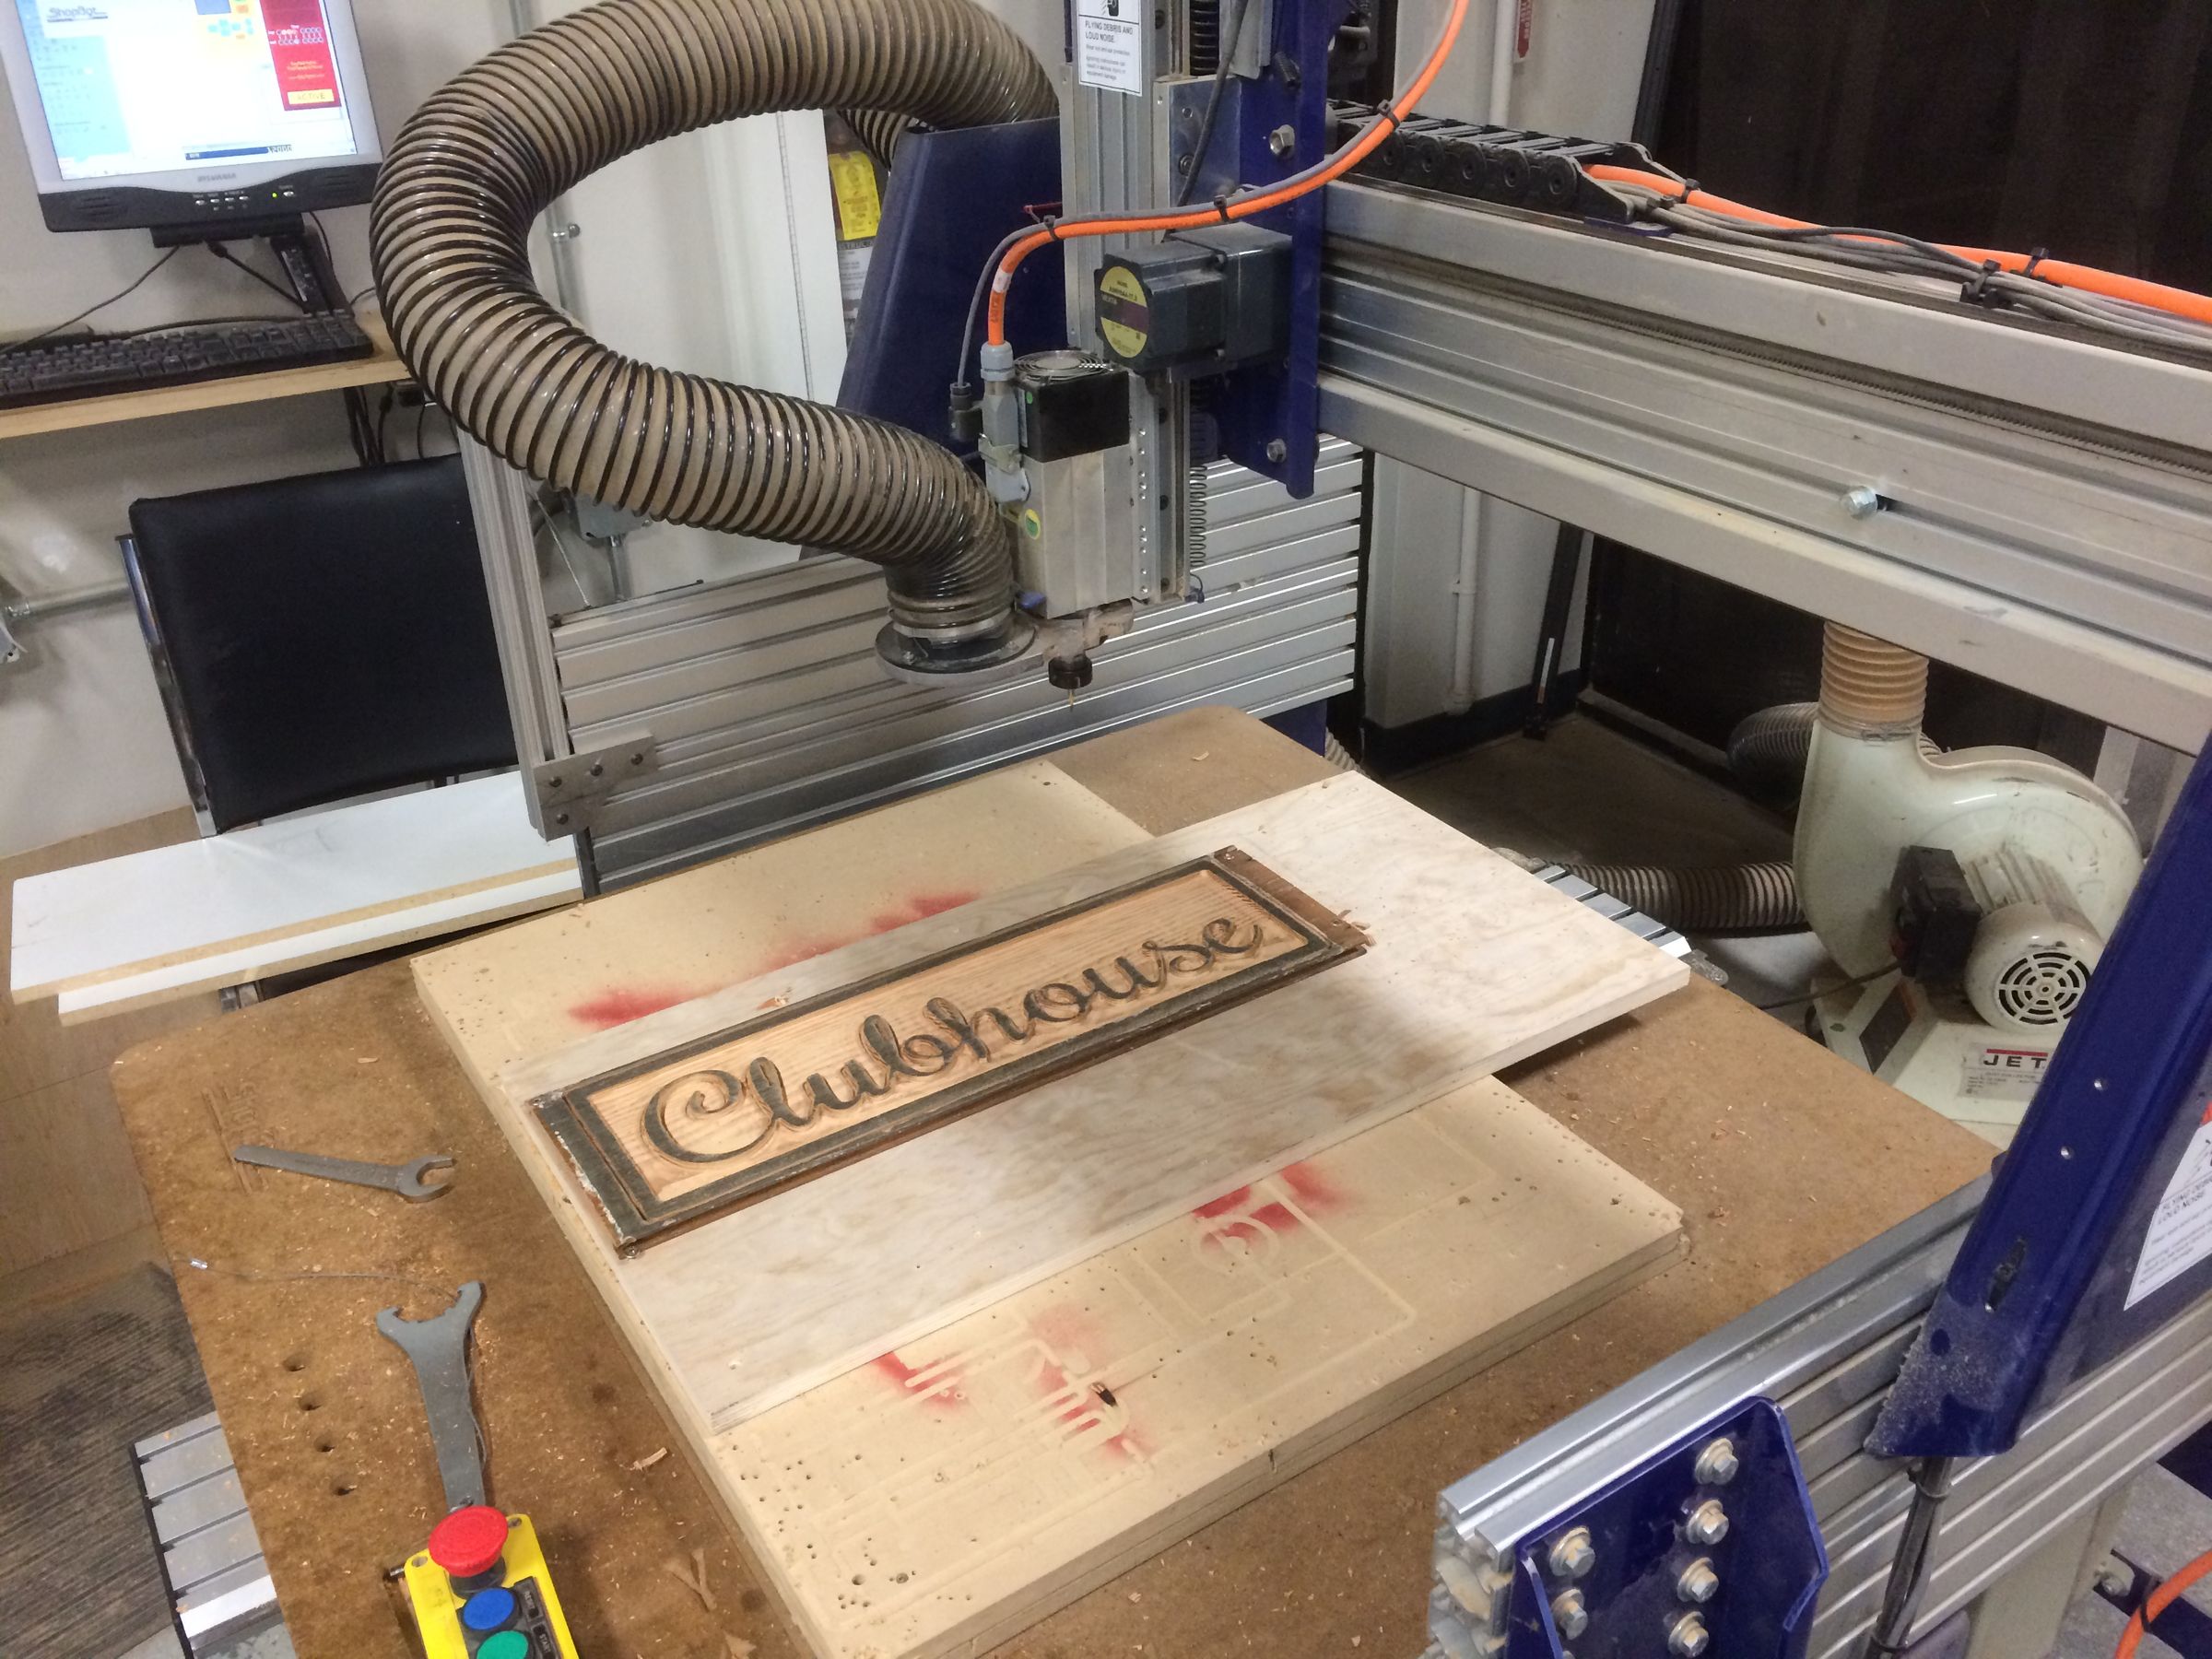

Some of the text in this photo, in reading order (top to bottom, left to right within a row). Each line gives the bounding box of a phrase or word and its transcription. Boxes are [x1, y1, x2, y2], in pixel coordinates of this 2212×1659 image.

[1086, 19, 1134, 35] FLYING DEBRIS AND
[1086, 31, 1099, 41] LOUD
[196, 172, 237, 182] SYLVANIA
[640, 913, 1265, 1166] Clubhouse
[1983, 1055, 2047, 1068] JET
[539, 1633, 552, 1653] START
